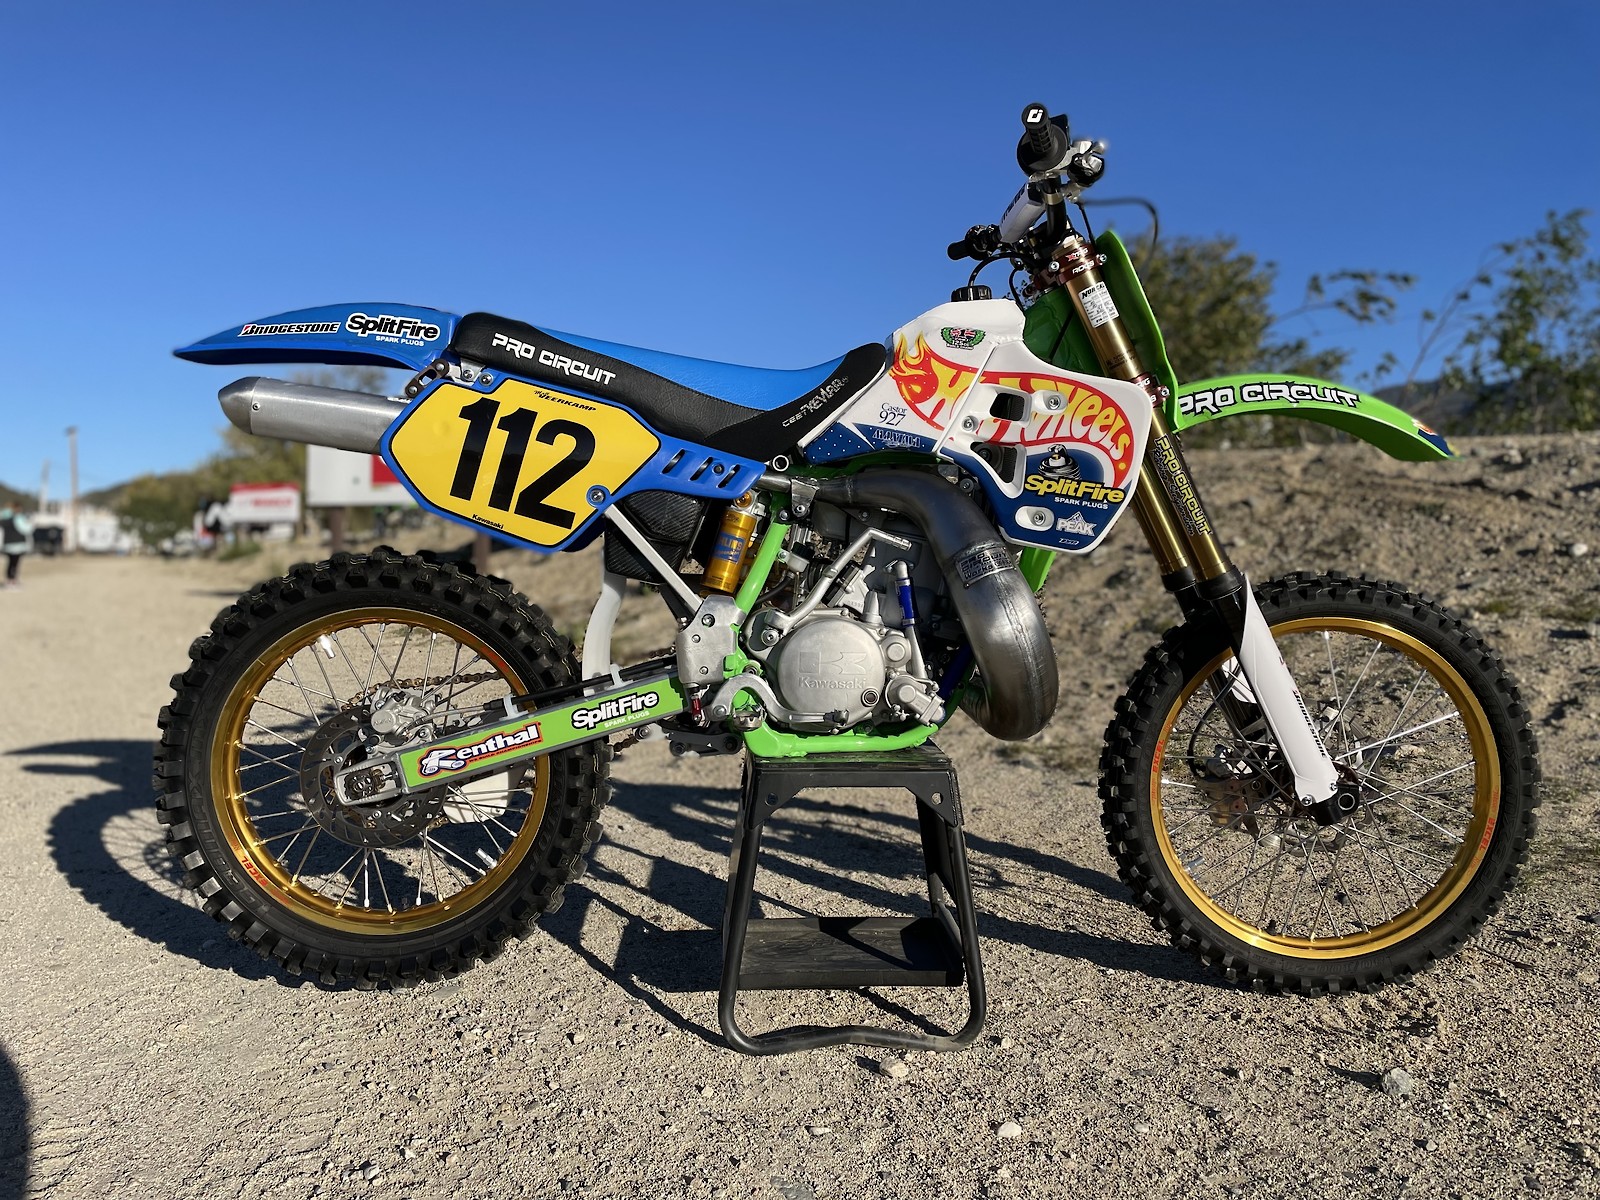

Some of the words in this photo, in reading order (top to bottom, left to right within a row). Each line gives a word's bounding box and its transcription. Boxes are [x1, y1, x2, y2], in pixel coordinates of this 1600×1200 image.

[242, 323, 340, 335] BRIDGESTONE
[349, 314, 439, 338] SplitFire
[492, 332, 535, 359] PRO
[539, 350, 616, 385] CIRCUIT
[538, 393, 597, 411] VEERKAMP
[881, 402, 907, 413] Castor
[1178, 388, 1235, 414] PRO
[1242, 384, 1359, 407] CIRCUIT
[879, 411, 907, 427] 927
[450, 396, 596, 529] 112
[1025, 475, 1125, 503] SplitFire
[1157, 434, 1182, 475] PRO
[1174, 473, 1211, 534] CIRCUIT
[1054, 497, 1080, 506] SPARK
[1082, 500, 1108, 509] PLUGS
[472, 514, 505, 529] Kawasaki
[1056, 517, 1097, 537] PEAK
[799, 676, 867, 689] Kawasaki
[573, 693, 658, 728] SplitFire
[604, 718, 627, 728] SPARK
[628, 711, 650, 722] PLUGS
[241, 856, 268, 887] EXCEL
